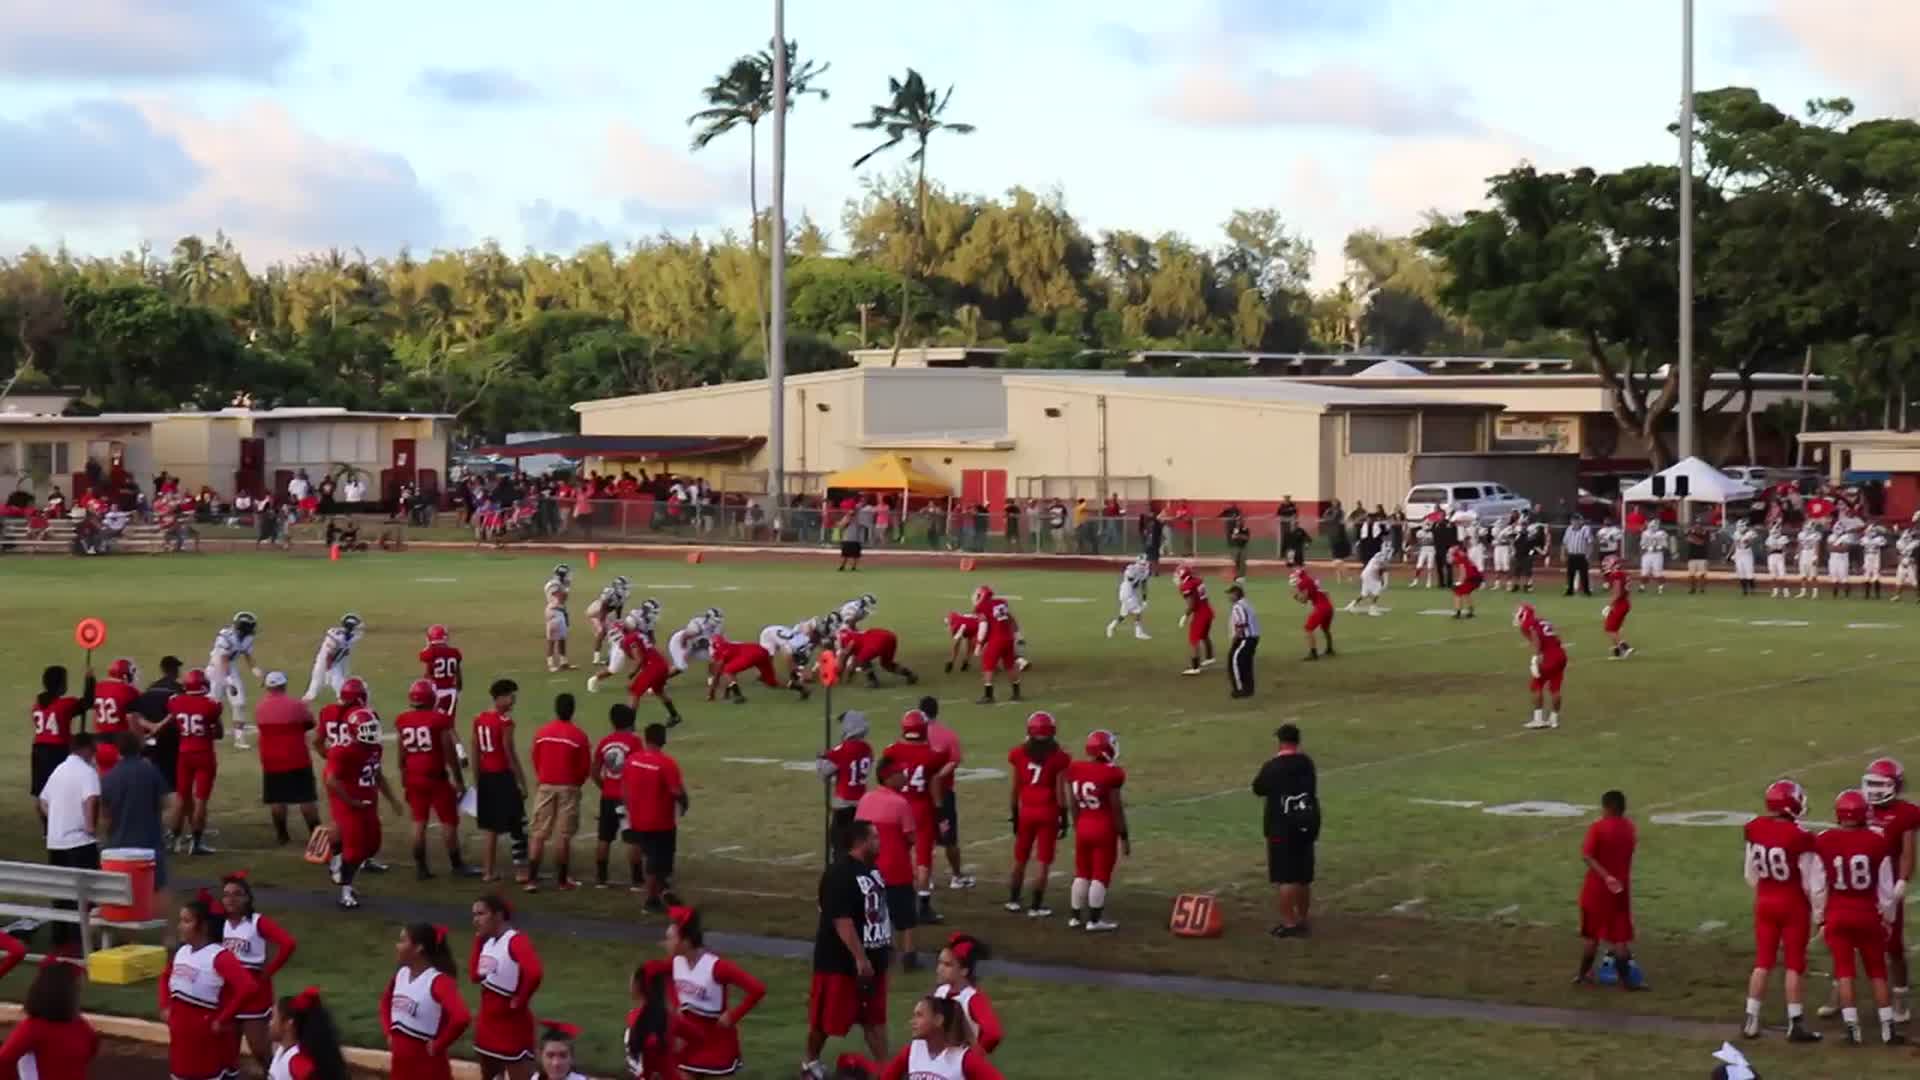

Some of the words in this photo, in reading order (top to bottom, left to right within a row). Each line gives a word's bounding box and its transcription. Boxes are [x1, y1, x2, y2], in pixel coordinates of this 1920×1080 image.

[434, 657, 458, 679] 20
[33, 711, 59, 736] 34
[95, 697, 120, 724] 32
[476, 725, 495, 752] 11
[1027, 763, 1042, 785] 7
[1833, 854, 1872, 891] 18
[1173, 896, 1212, 930] 50
